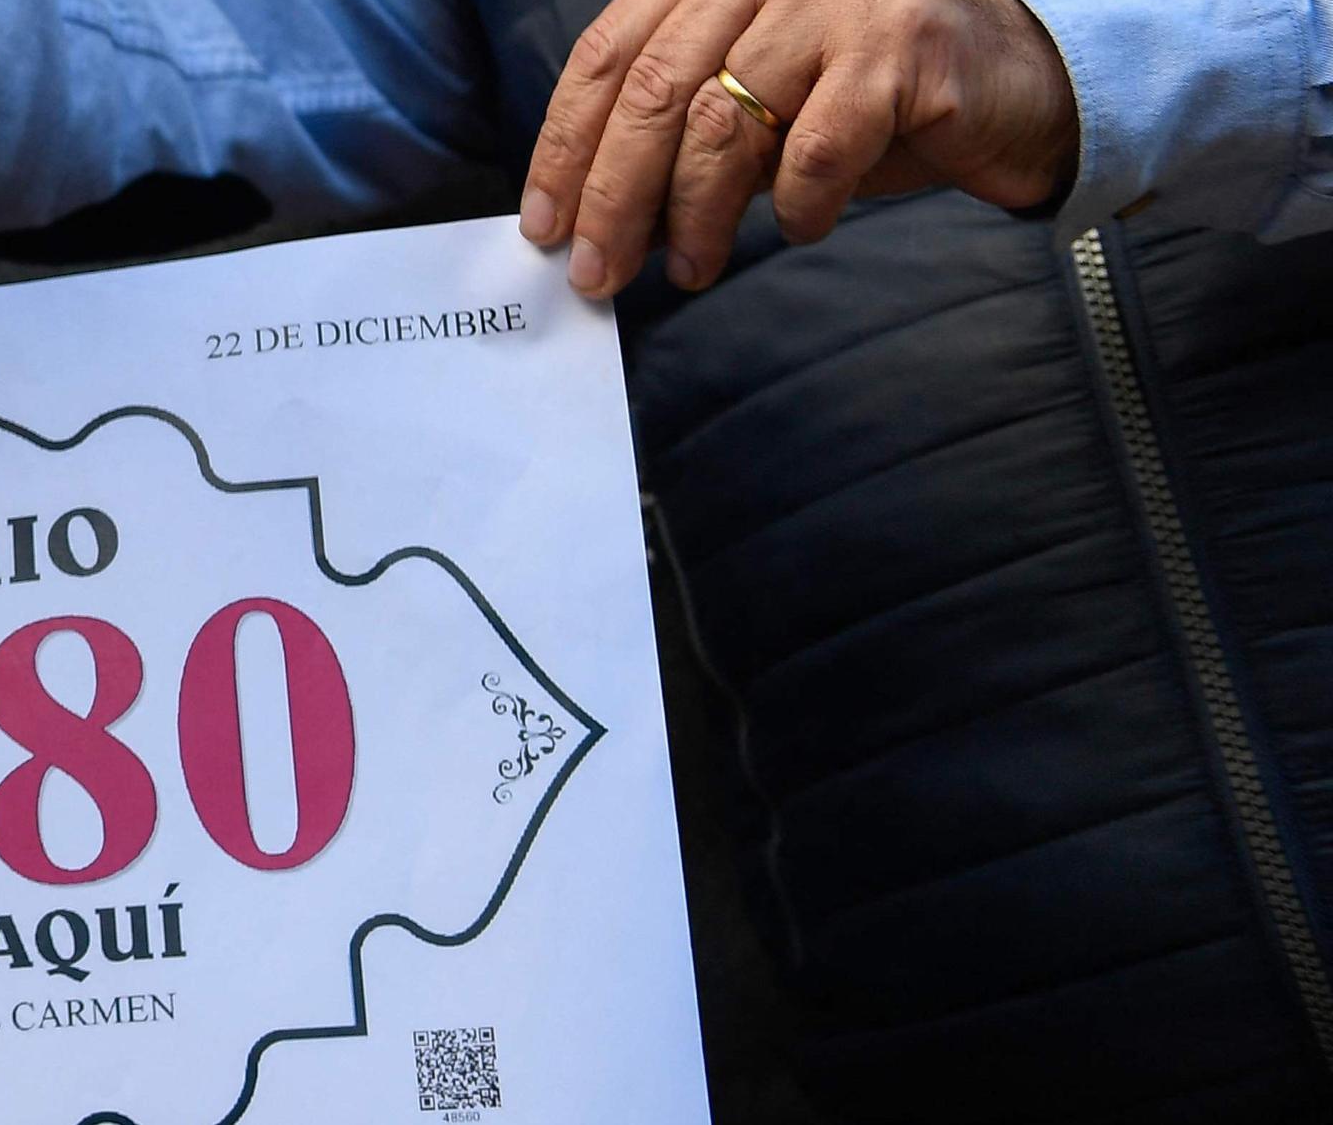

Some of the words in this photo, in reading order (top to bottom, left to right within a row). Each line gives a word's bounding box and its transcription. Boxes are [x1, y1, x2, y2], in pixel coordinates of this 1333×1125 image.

[205, 331, 243, 360] 22
[255, 325, 304, 353] DE
[316, 303, 527, 347] DICIEMBRE
[11, 992, 176, 1031] CARMEN
